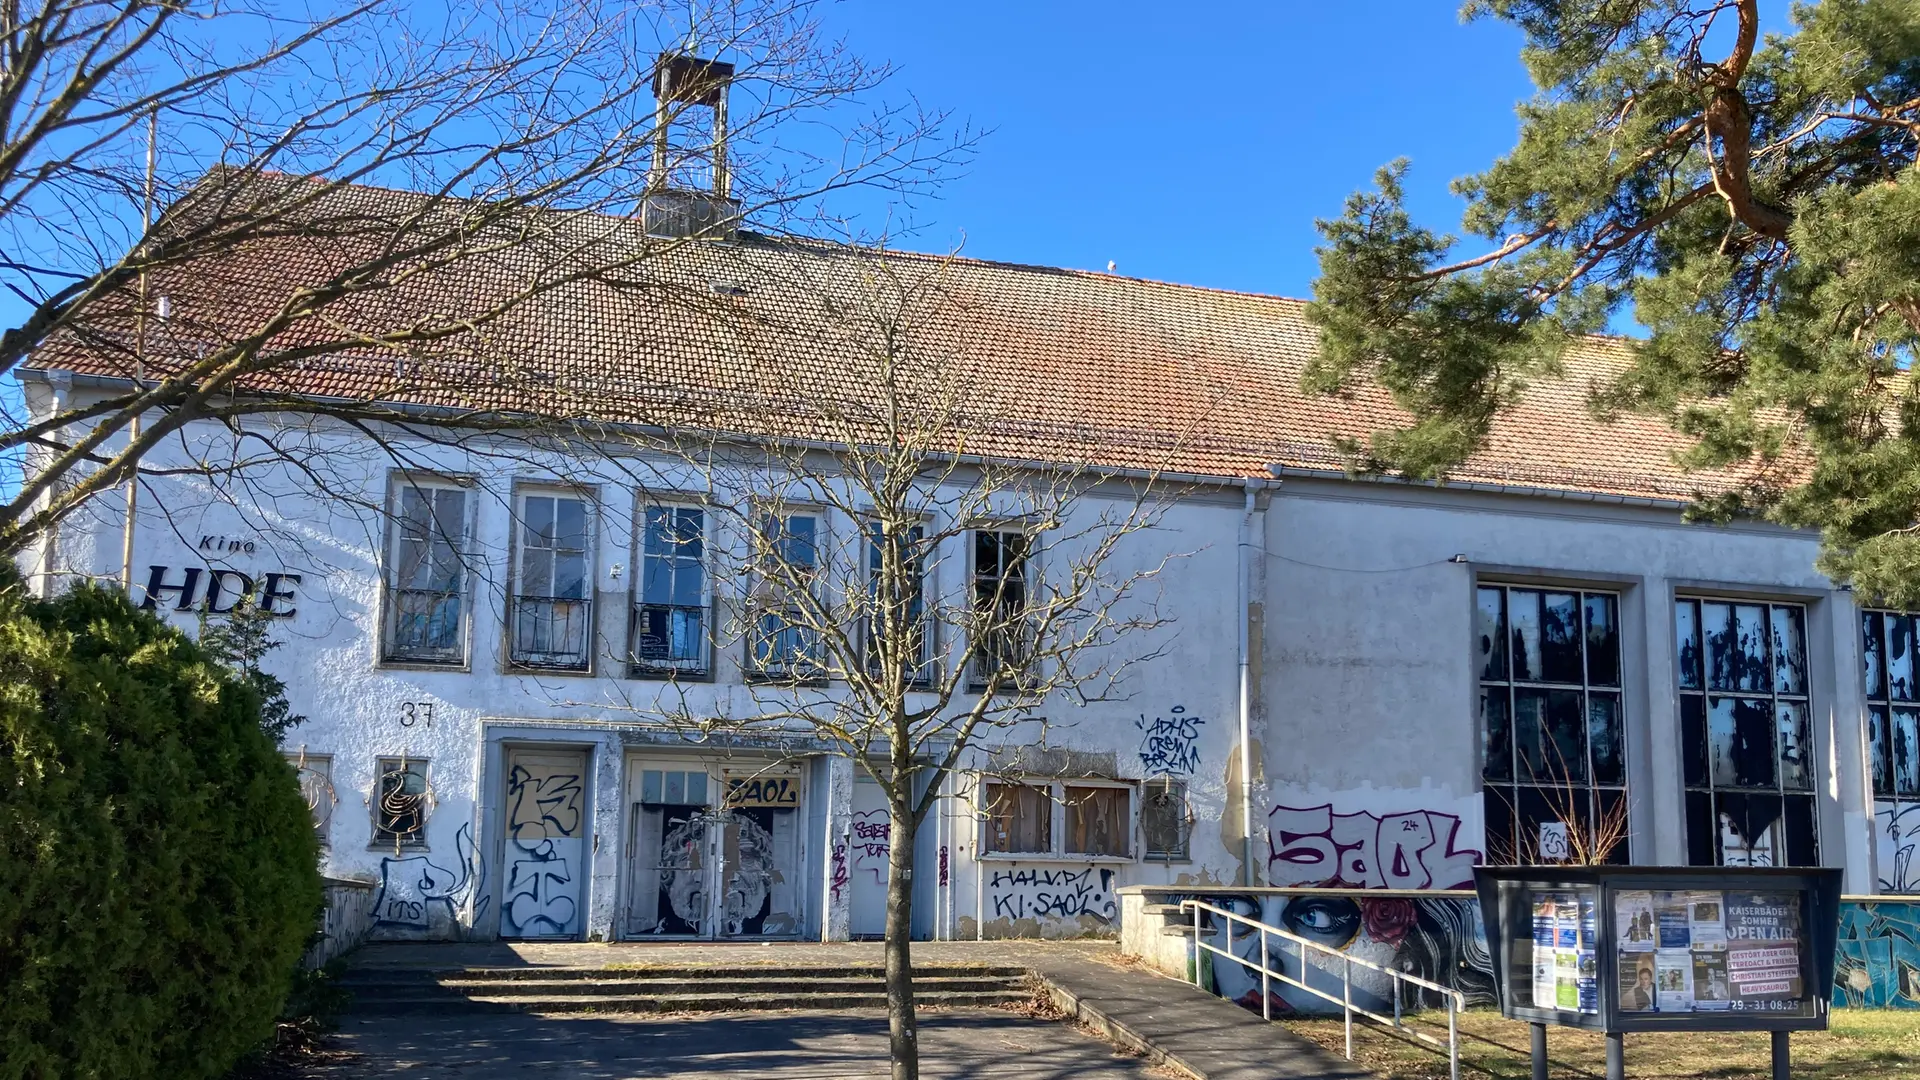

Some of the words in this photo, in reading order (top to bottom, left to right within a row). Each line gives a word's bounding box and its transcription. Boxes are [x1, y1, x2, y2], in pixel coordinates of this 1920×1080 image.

[199, 535, 256, 553] Kino
[138, 565, 302, 618] HDE
[400, 701, 433, 728] 37
[1145, 716, 1206, 740] ADHS
[726, 778, 797, 803] SAOL
[1402, 819, 1419, 832] 24
[1728, 906, 1788, 916] KAISERBÄDER
[1741, 916, 1779, 926] SOMMER
[1769, 927, 1794, 940] AIR
[1731, 951, 1760, 959] GESTÖRT
[1762, 950, 1778, 958] ABER
[1727, 959, 1765, 969] STEREOACT
[1772, 957, 1798, 966] FRIENDS
[1731, 971, 1767, 981] CHRISTIAN
[1768, 969, 1797, 978] STEIFFEN
[1741, 983, 1789, 993] HEAVYSAURUS
